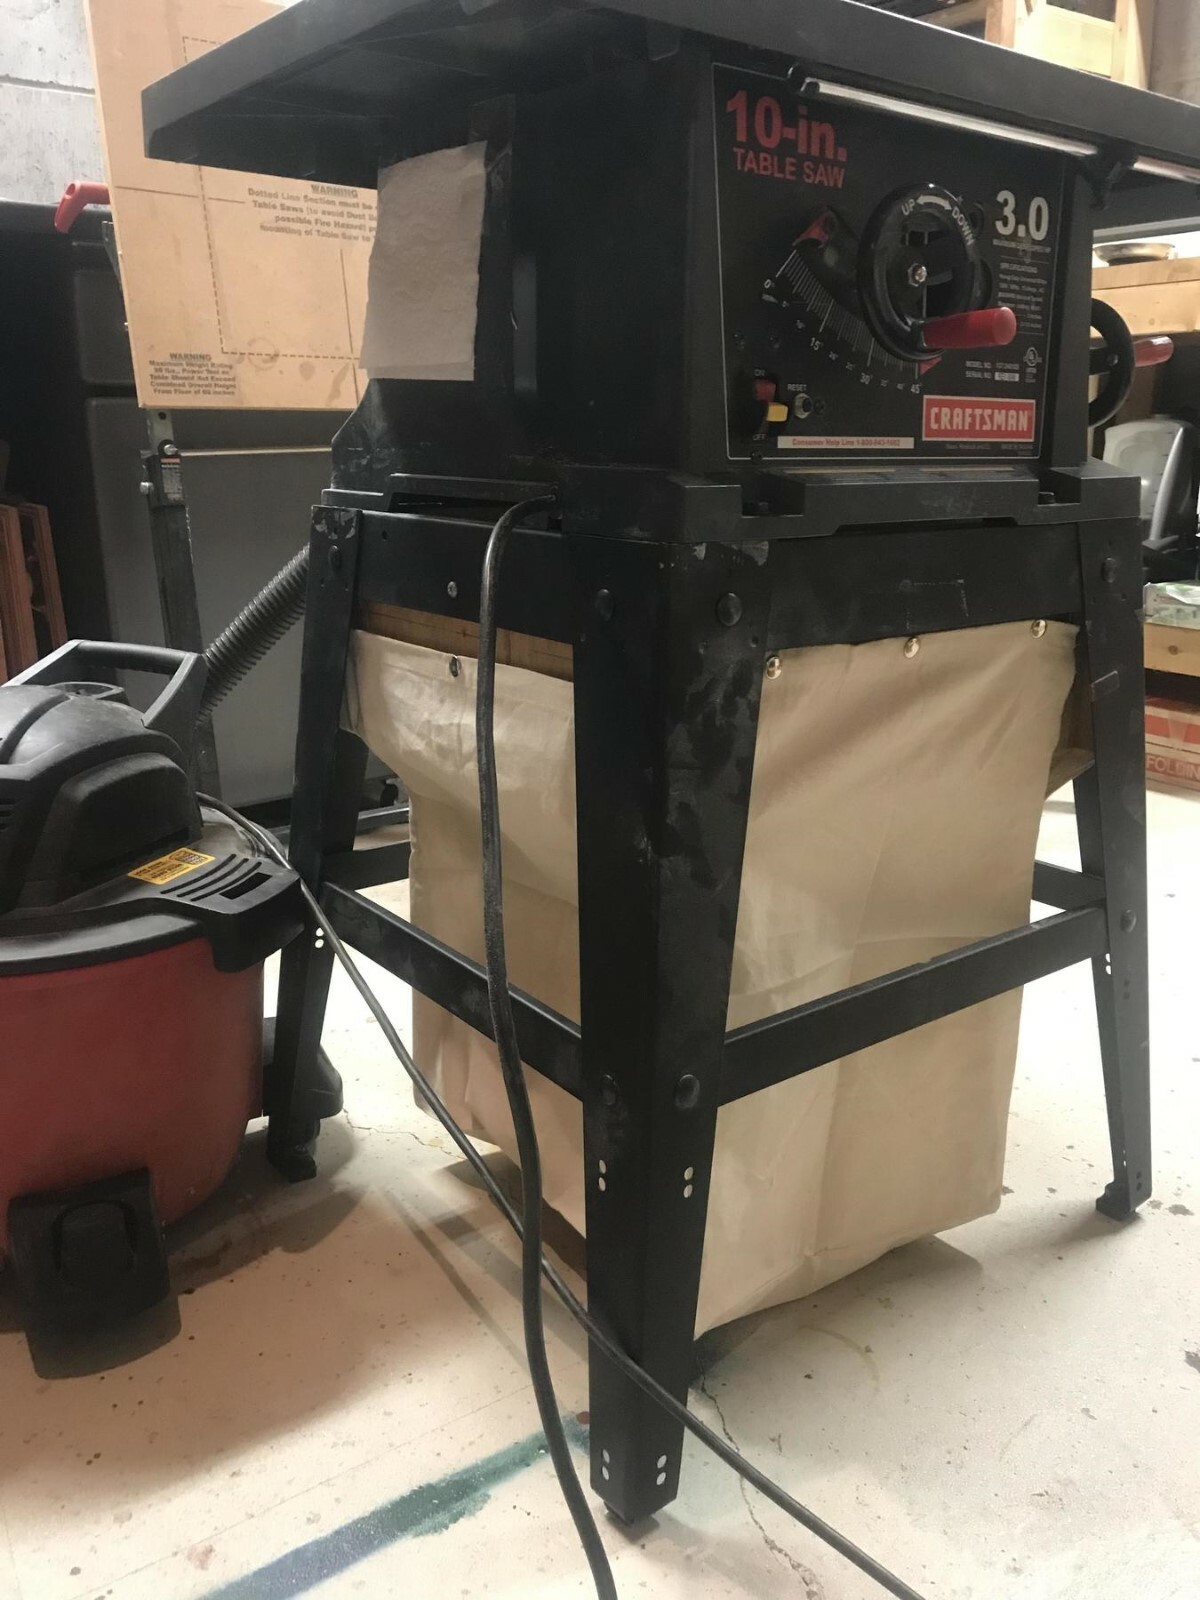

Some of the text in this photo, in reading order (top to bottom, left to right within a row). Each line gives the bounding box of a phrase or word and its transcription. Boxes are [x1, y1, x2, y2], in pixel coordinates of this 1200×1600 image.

[726, 90, 847, 161] 10-in.
[733, 147, 845, 188] TABLE SAW
[248, 187, 279, 199] Dotted
[303, 195, 336, 206] Section
[311, 184, 358, 199] WARNING
[252, 200, 278, 210] Table
[901, 199, 915, 215] UP
[995, 190, 1049, 240] 3.0
[952, 206, 975, 246] DOWN
[787, 383, 808, 392] RESET
[930, 407, 1029, 432] CRAFTSMAN
[792, 438, 825, 446] Consumer
